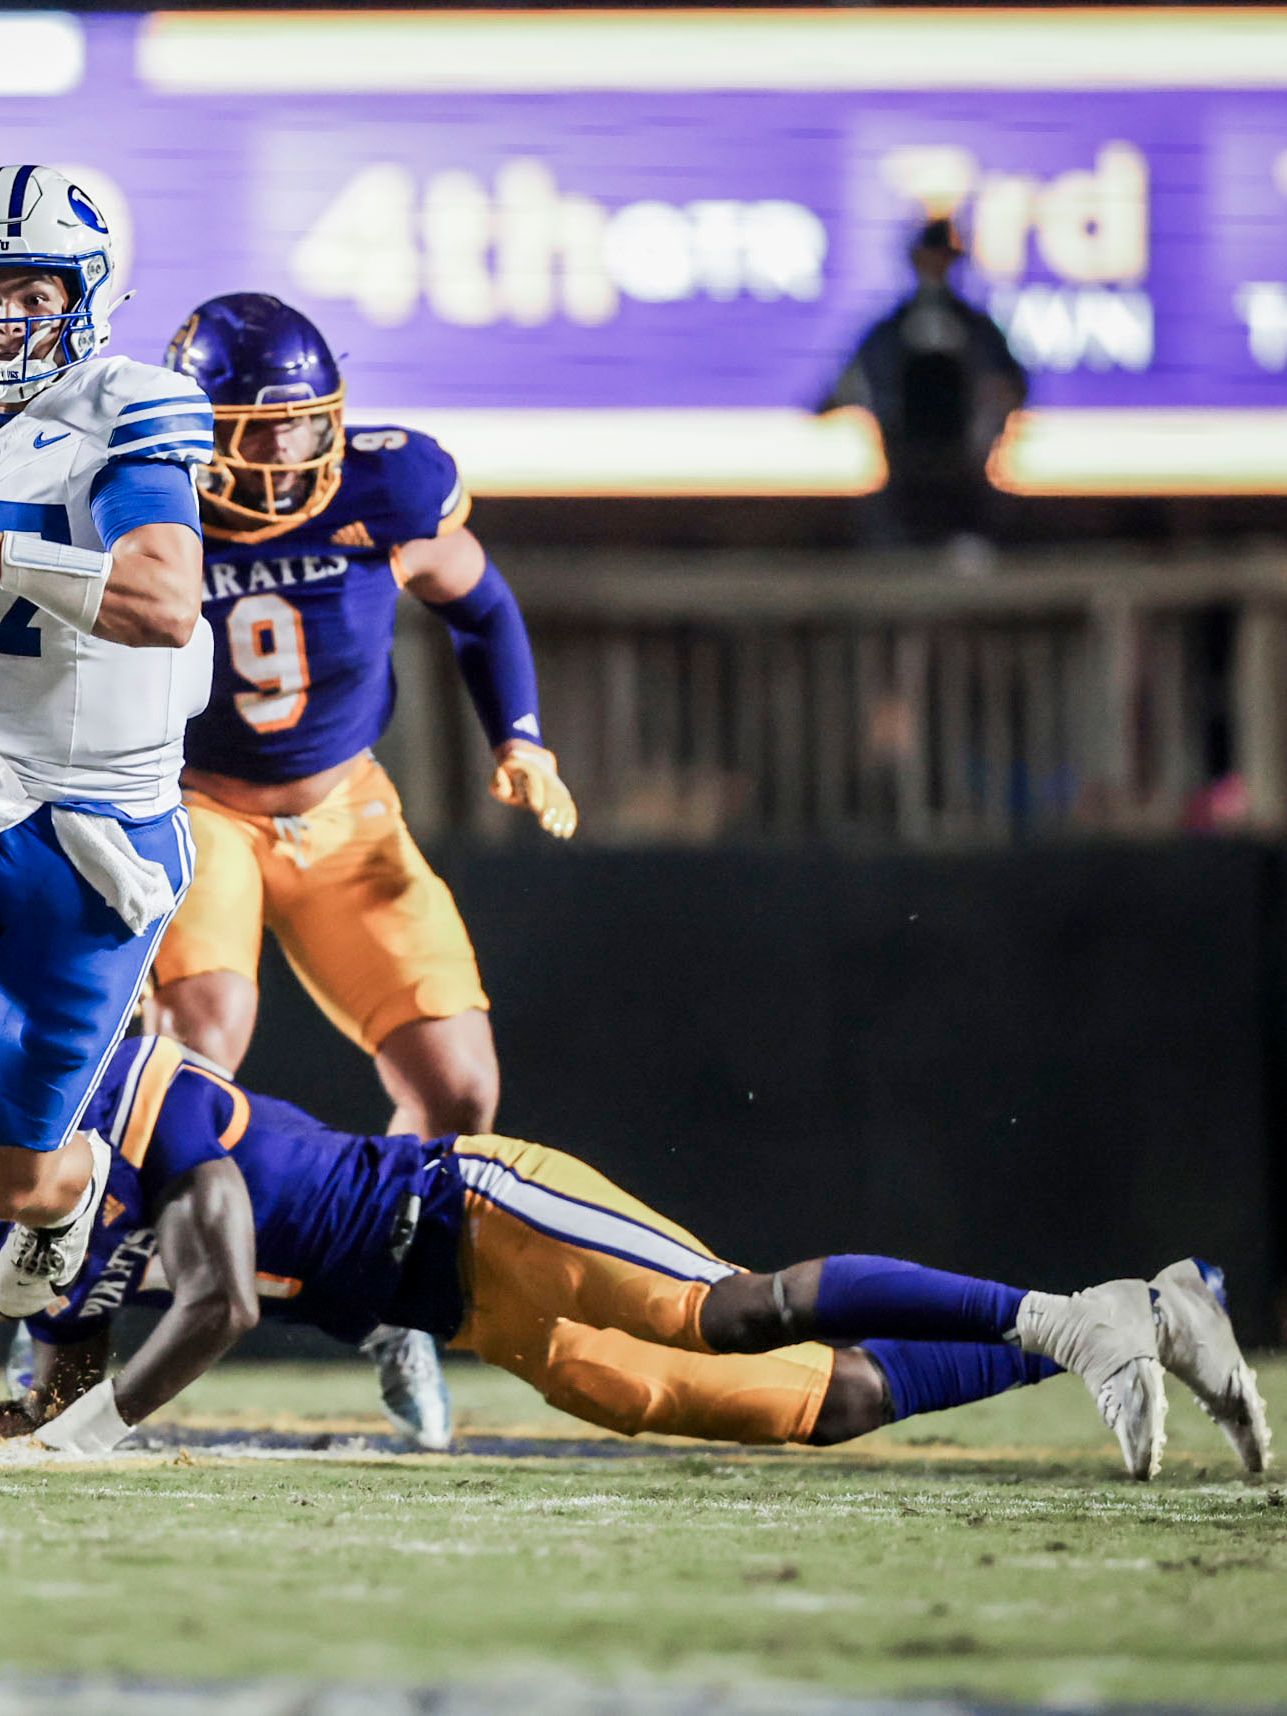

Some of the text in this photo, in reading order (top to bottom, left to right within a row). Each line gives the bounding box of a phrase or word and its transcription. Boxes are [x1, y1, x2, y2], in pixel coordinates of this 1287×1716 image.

[290, 160, 619, 327] 4th
[351, 429, 408, 451] 9
[227, 593, 311, 735] 9
